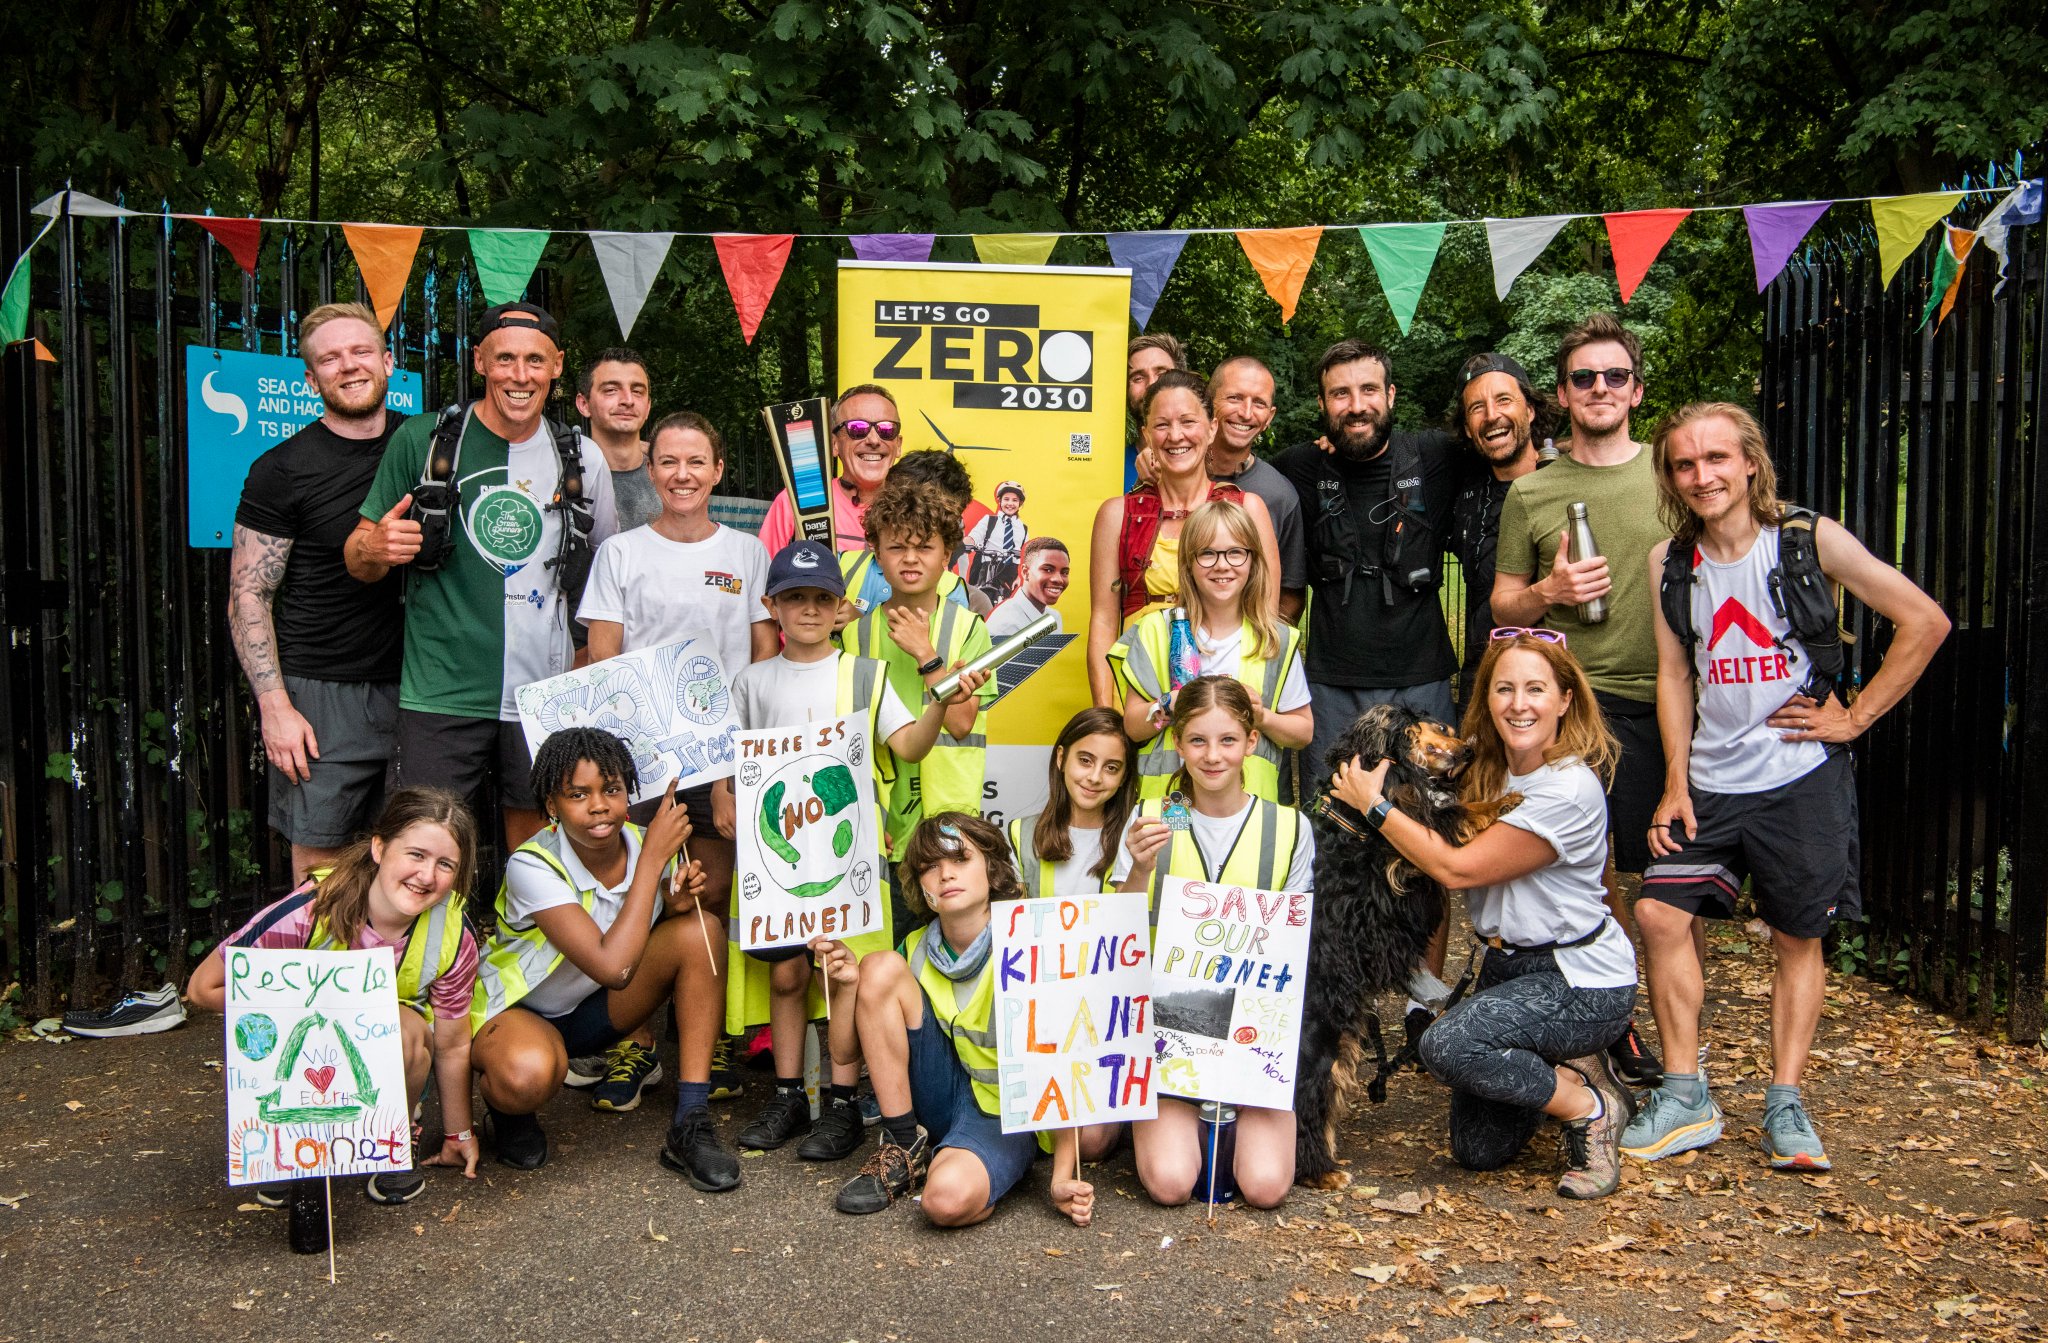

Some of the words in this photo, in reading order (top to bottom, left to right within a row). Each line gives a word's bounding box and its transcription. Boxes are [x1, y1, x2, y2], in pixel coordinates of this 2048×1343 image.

[879, 304, 946, 322] LET'S
[955, 306, 991, 323] GO
[873, 325, 1094, 385] ZERO
[257, 377, 288, 396] SEA
[386, 391, 413, 408] TON
[257, 397, 290, 414] AND
[293, 400, 324, 417] HAC
[1001, 386, 1087, 410] 2030
[257, 420, 279, 438] TS
[281, 422, 306, 439] BU
[1707, 653, 1792, 685] HELTER
[741, 736, 803, 758] THERE
[816, 721, 845, 748] IS
[784, 797, 824, 841] NO
[1161, 814, 1193, 824] earth
[1008, 899, 1100, 938] STOP
[1181, 881, 1307, 927] SAVE
[750, 903, 851, 945] PLANET
[1194, 918, 1270, 955] OUR
[1000, 933, 1146, 992] KILLING
[355, 1013, 400, 1041] Save
[303, 1044, 342, 1067] We
[228, 1066, 261, 1091] The
[1000, 1053, 1153, 1129] EARTH
